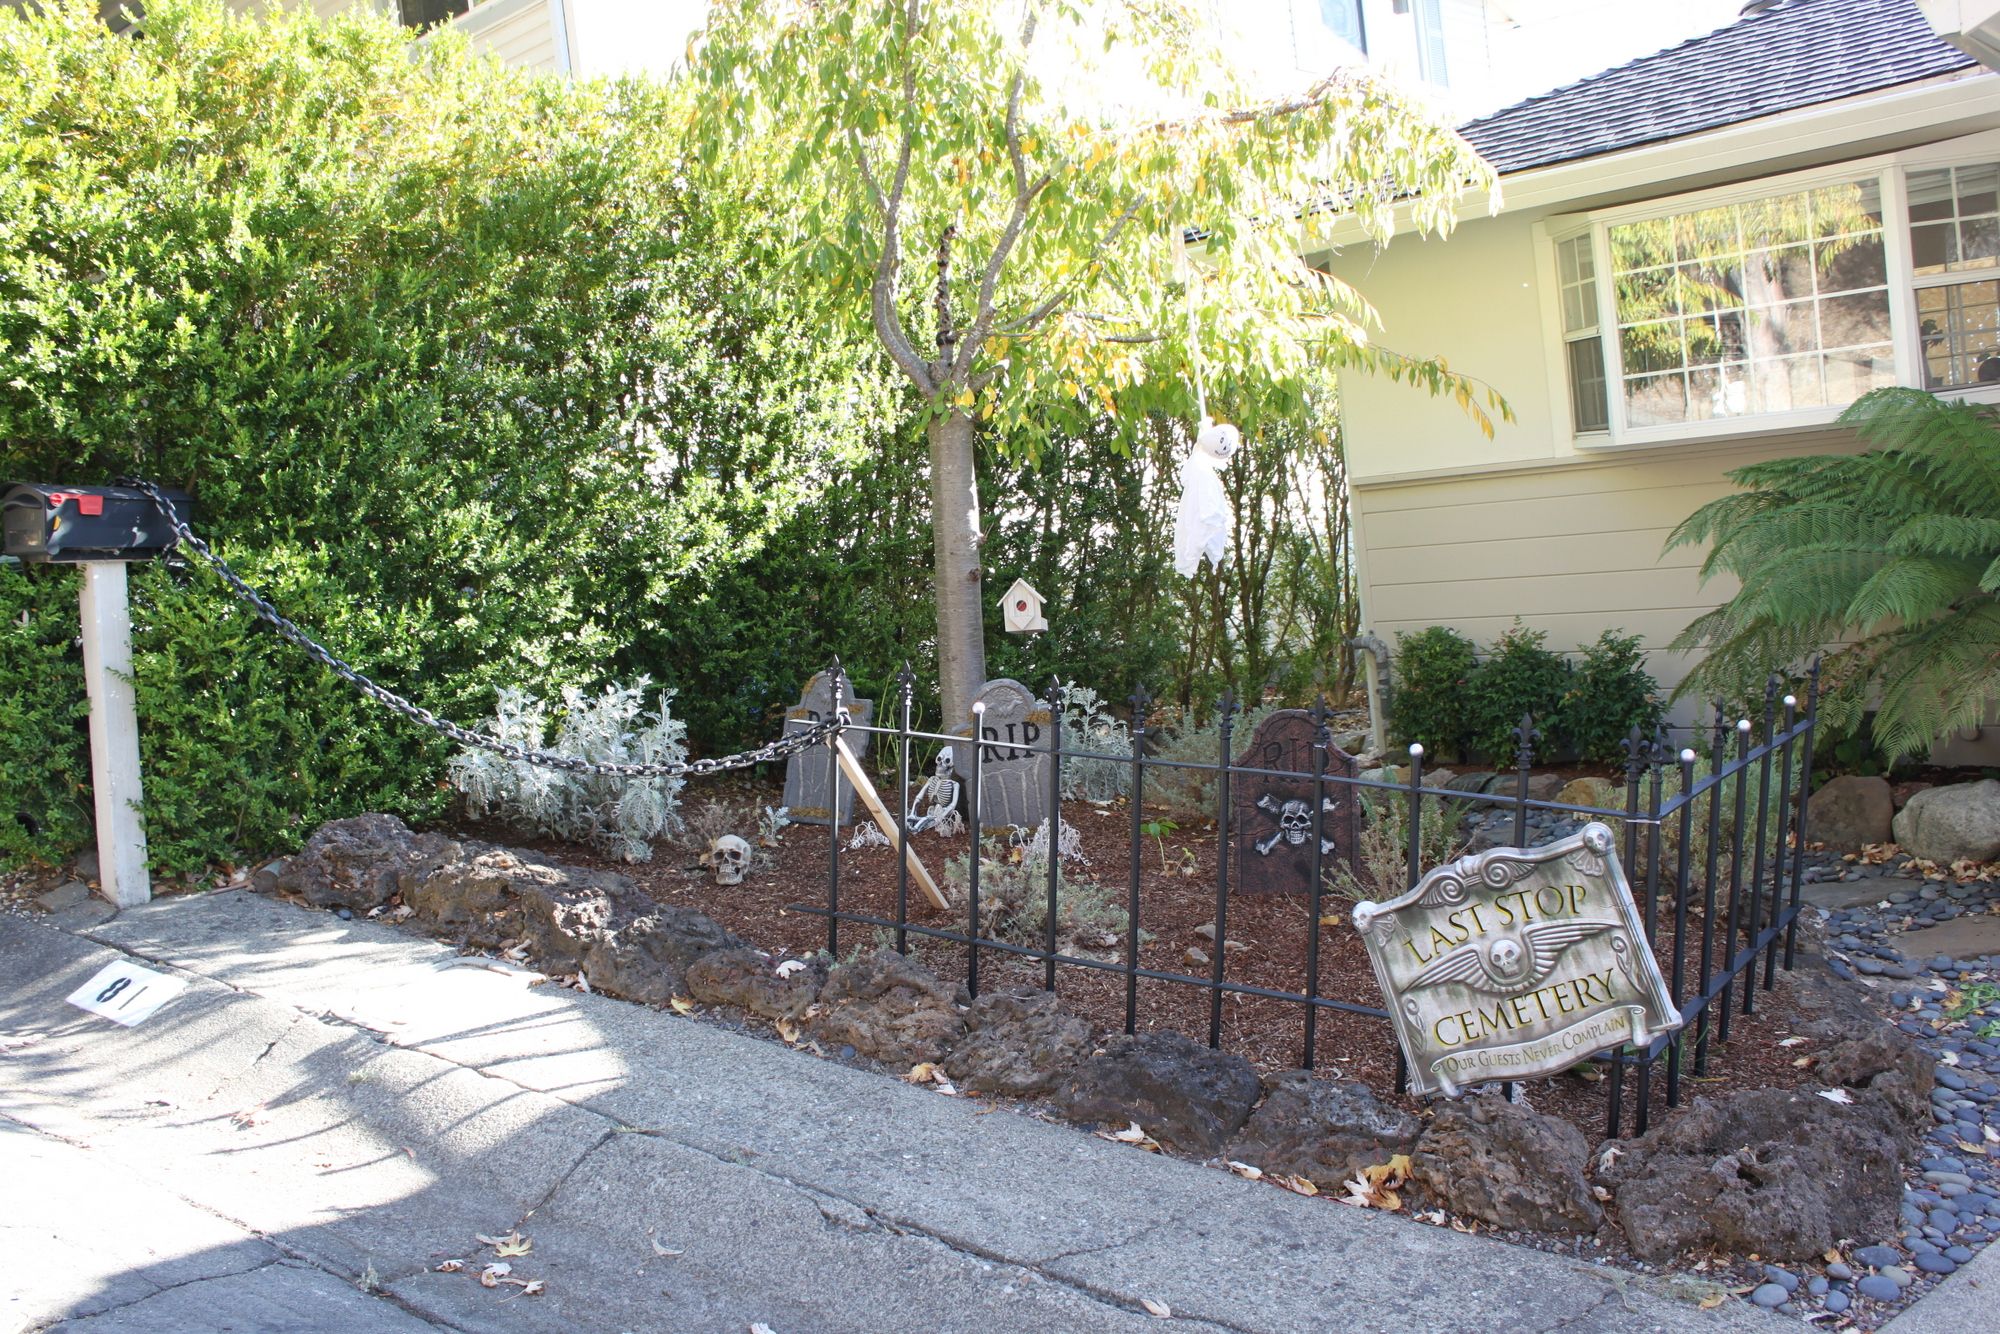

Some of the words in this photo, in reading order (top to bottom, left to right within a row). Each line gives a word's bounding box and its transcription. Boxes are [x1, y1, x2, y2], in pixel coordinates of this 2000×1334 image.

[982, 721, 1040, 763] RIP
[1403, 903, 1488, 966] LAST
[1494, 884, 1586, 926] STOP
[1434, 968, 1615, 1047] CEMETERY
[1447, 1057, 1475, 1073] OUR
[1477, 1051, 1521, 1067] GUESTS
[1523, 1043, 1561, 1066] NEVER
